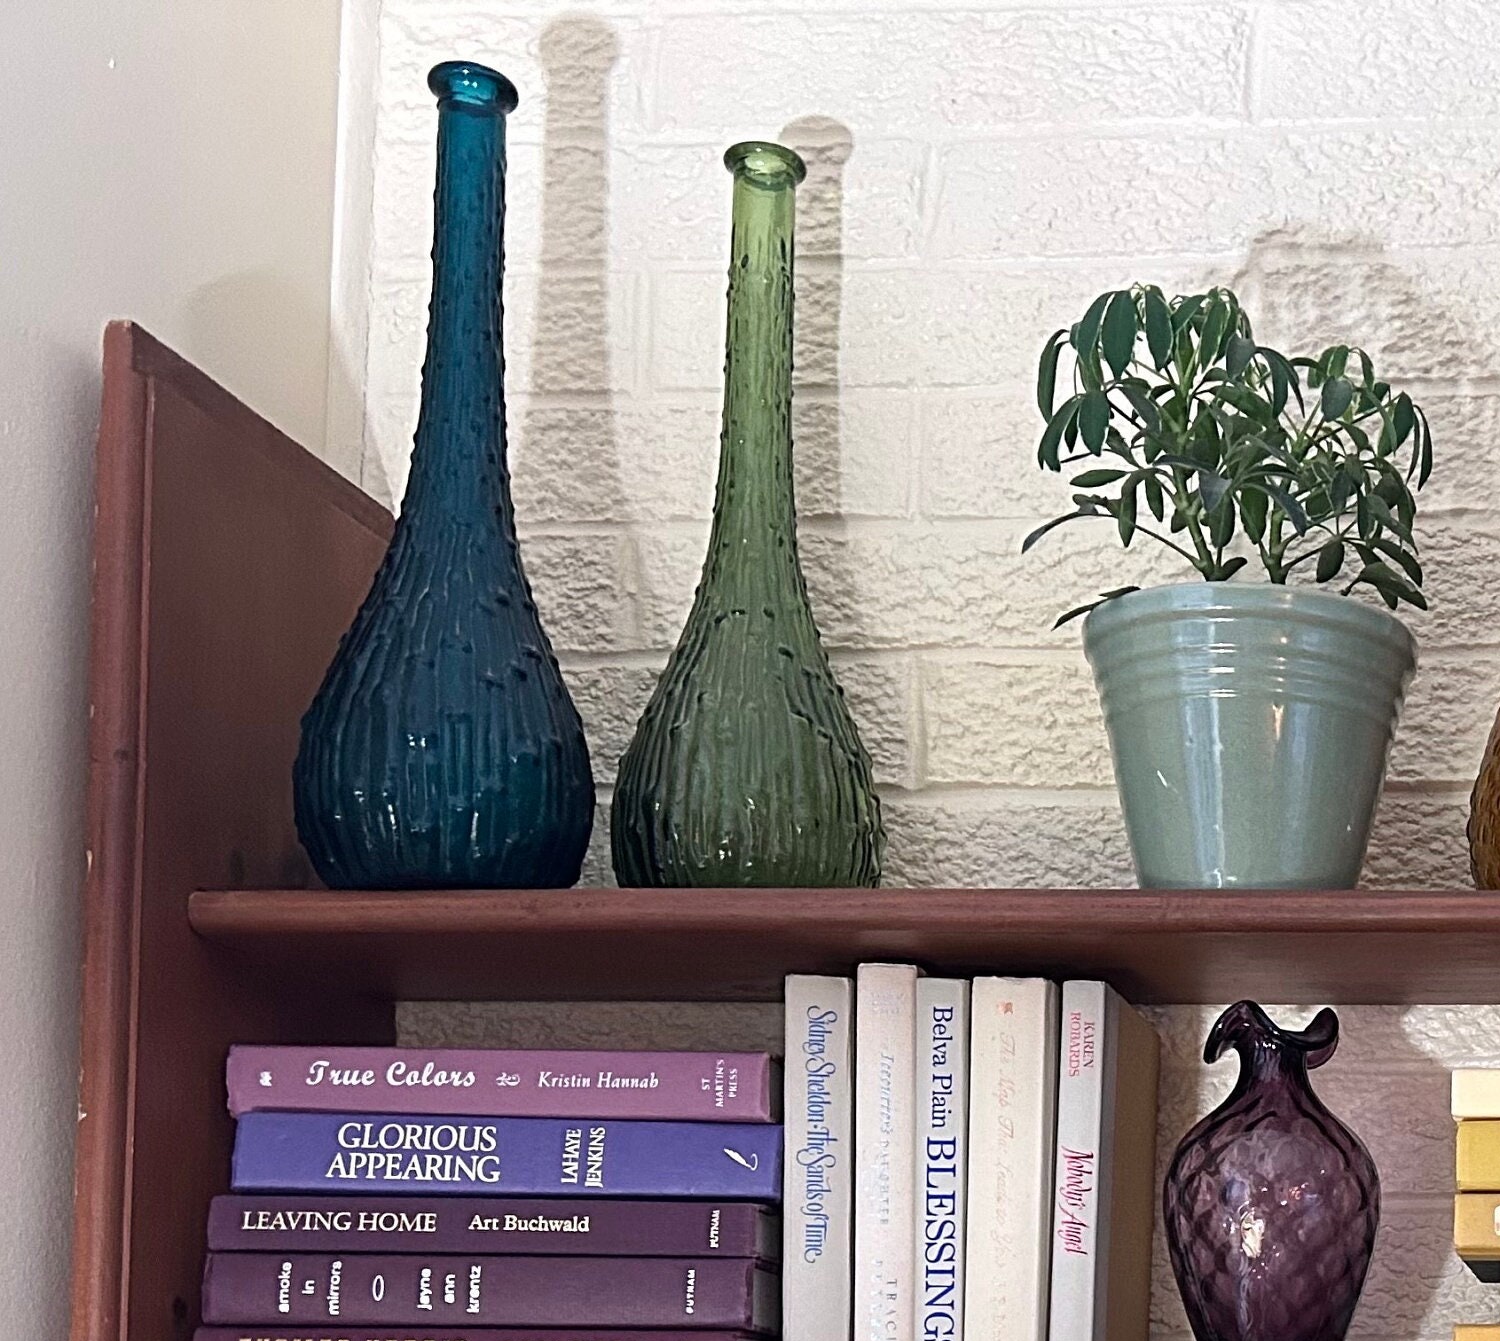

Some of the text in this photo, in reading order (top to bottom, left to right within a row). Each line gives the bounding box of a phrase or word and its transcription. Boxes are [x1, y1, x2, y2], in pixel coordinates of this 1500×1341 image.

[1069, 1011, 1081, 1078] ROBARDS
[1083, 1021, 1094, 1069] KAREN
[305, 1061, 476, 1087] True Colors
[538, 1072, 659, 1089] Kristin Hannah
[931, 1006, 954, 1128] Belva Plain
[337, 1123, 497, 1152] GLORIOUS
[325, 1154, 500, 1182] APPEARING
[585, 1126, 606, 1187] JENKINS
[242, 1211, 437, 1233] LEAVING HOME
[468, 1215, 590, 1233] Art Buchwald
